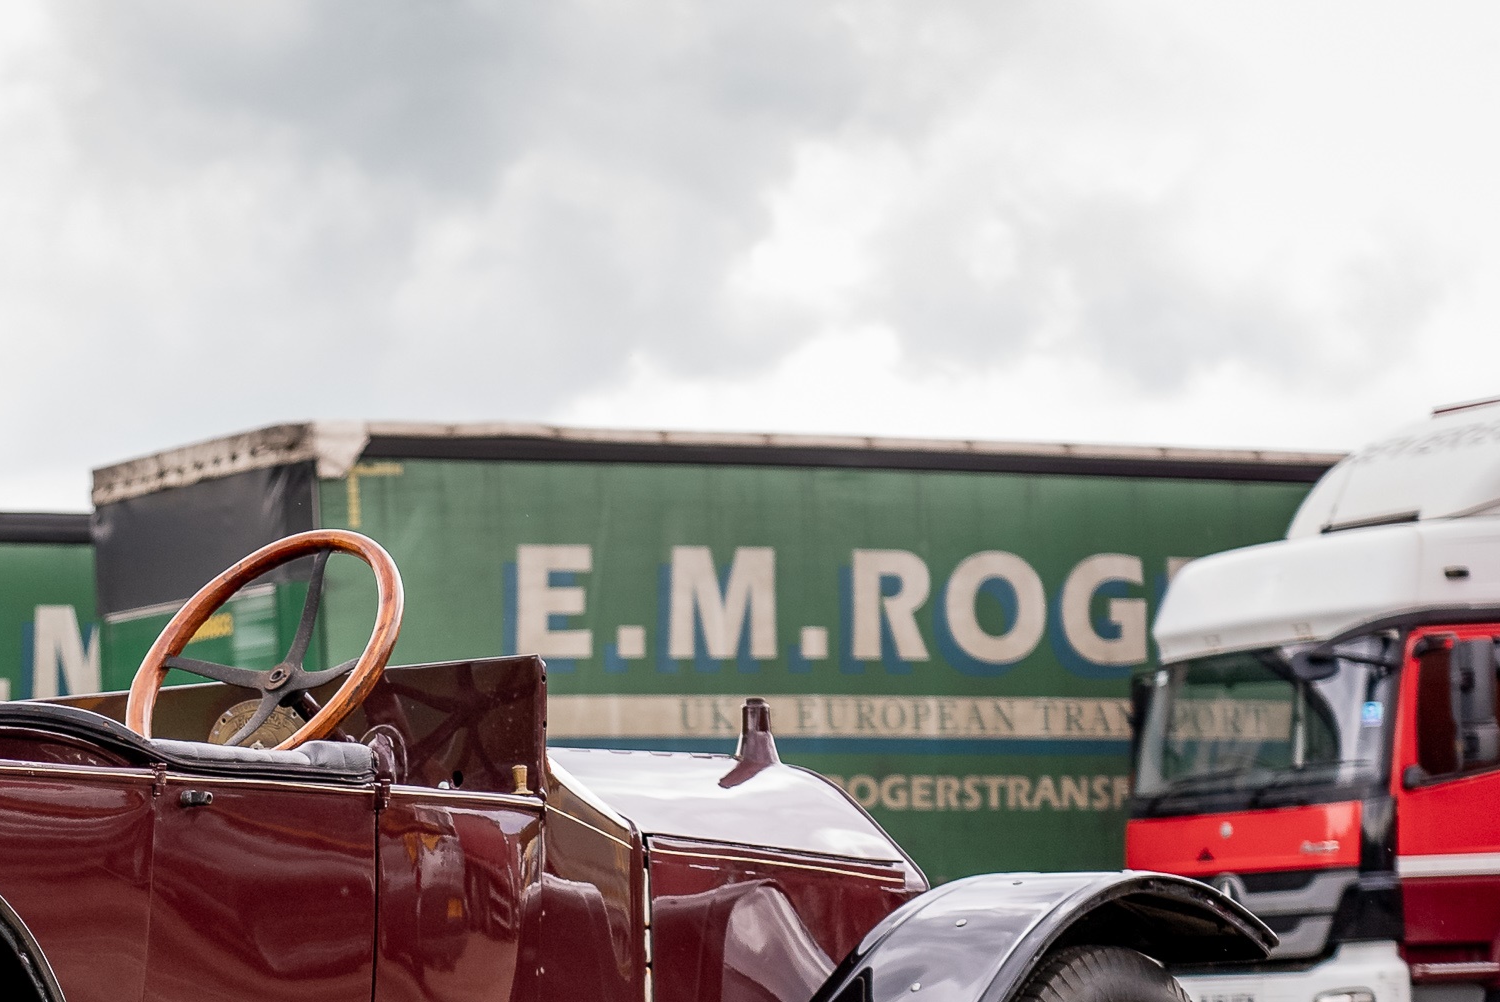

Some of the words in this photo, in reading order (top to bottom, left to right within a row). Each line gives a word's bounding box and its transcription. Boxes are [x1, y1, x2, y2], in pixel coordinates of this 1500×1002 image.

[516, 544, 1199, 665] E.M.ROG
[679, 702, 736, 733] UK
[796, 702, 1016, 734] EUROPEAN
